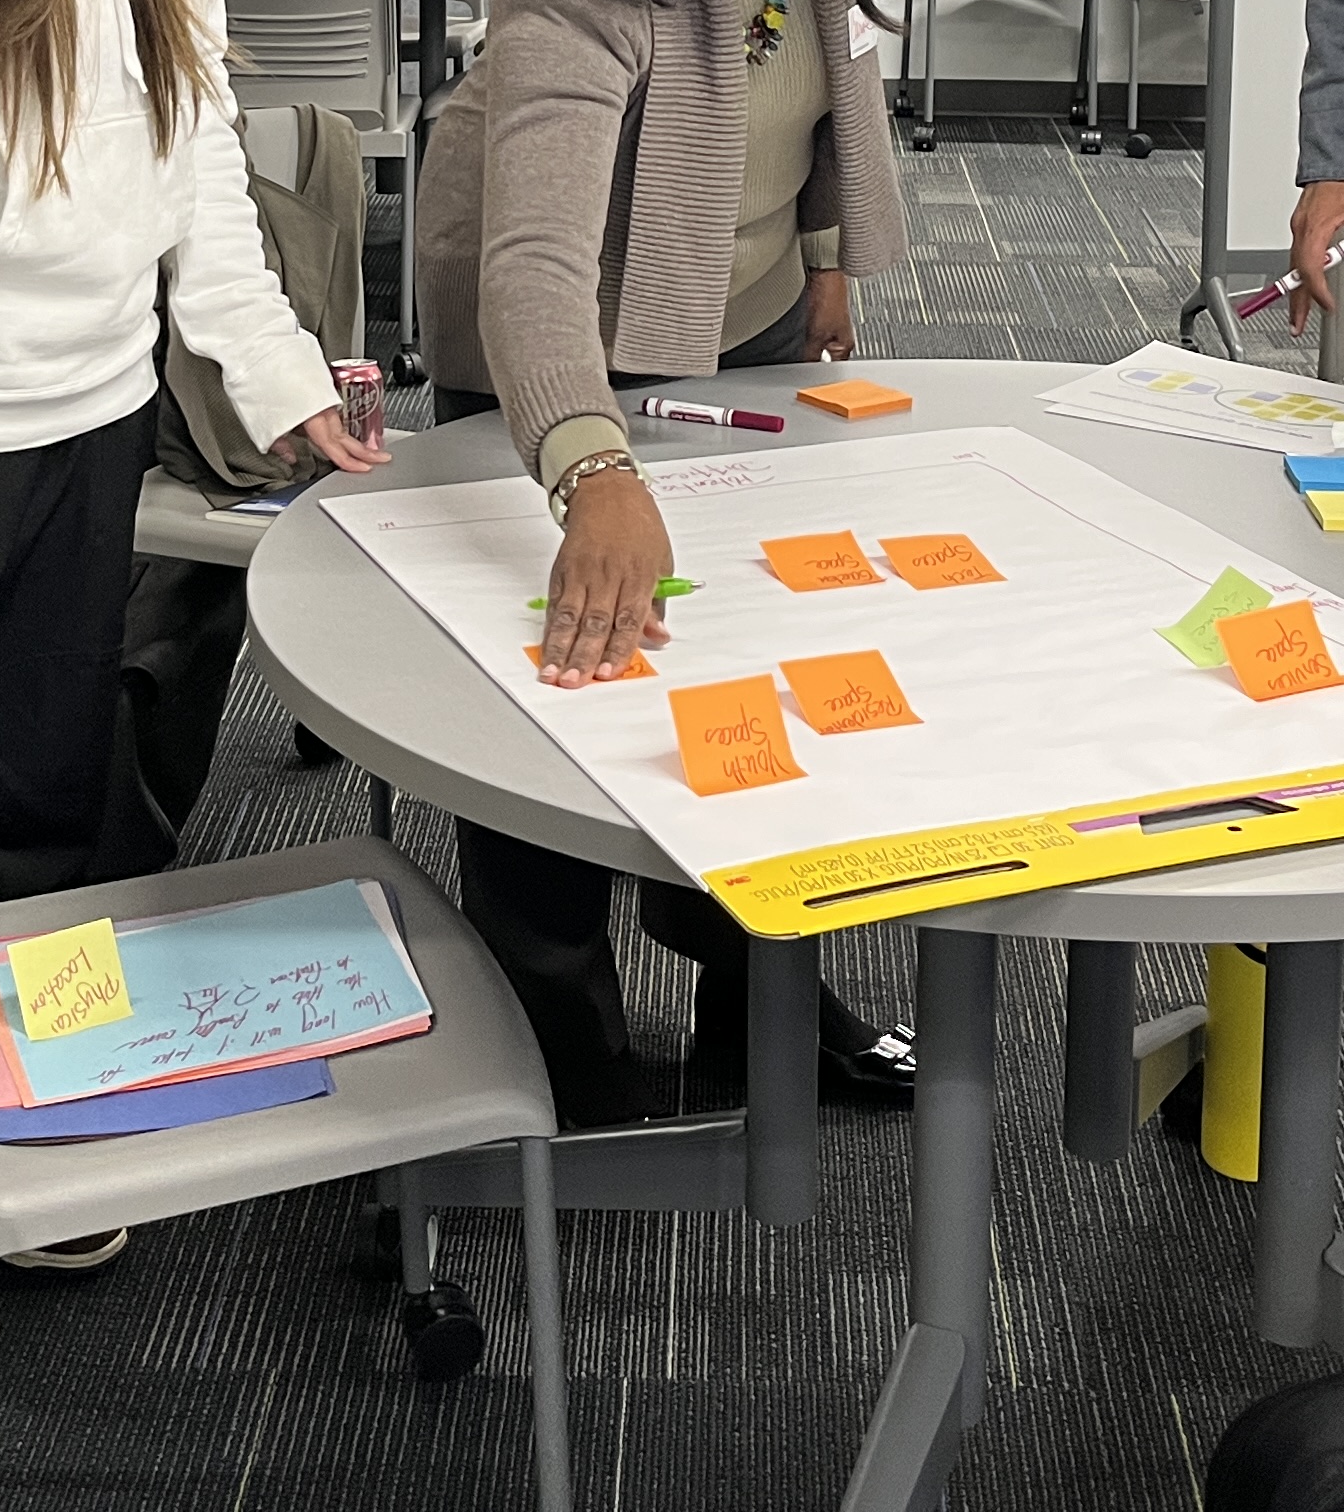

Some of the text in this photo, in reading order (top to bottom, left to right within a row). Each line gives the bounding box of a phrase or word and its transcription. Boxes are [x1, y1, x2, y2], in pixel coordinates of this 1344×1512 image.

[803, 551, 860, 570] Space
[911, 541, 973, 569] Spaces
[941, 564, 992, 586] Tech
[1255, 619, 1309, 663] Space
[1267, 652, 1332, 693] Services
[823, 678, 873, 713] Space
[704, 702, 767, 747] Spaces
[722, 739, 790, 786] Youth
[1010, 841, 1033, 853] 30
[748, 872, 847, 904] IN/PO/PULG.
[842, 869, 865, 883] 30
[28, 946, 93, 1016] Location
[336, 971, 368, 991] the
[50, 972, 120, 1034] Physical
[265, 998, 282, 1014] to
[352, 989, 392, 1016] How
[300, 1003, 336, 1034] long
[250, 1028, 281, 1047] will
[151, 1042, 194, 1064] take
[87, 1064, 126, 1084] for
